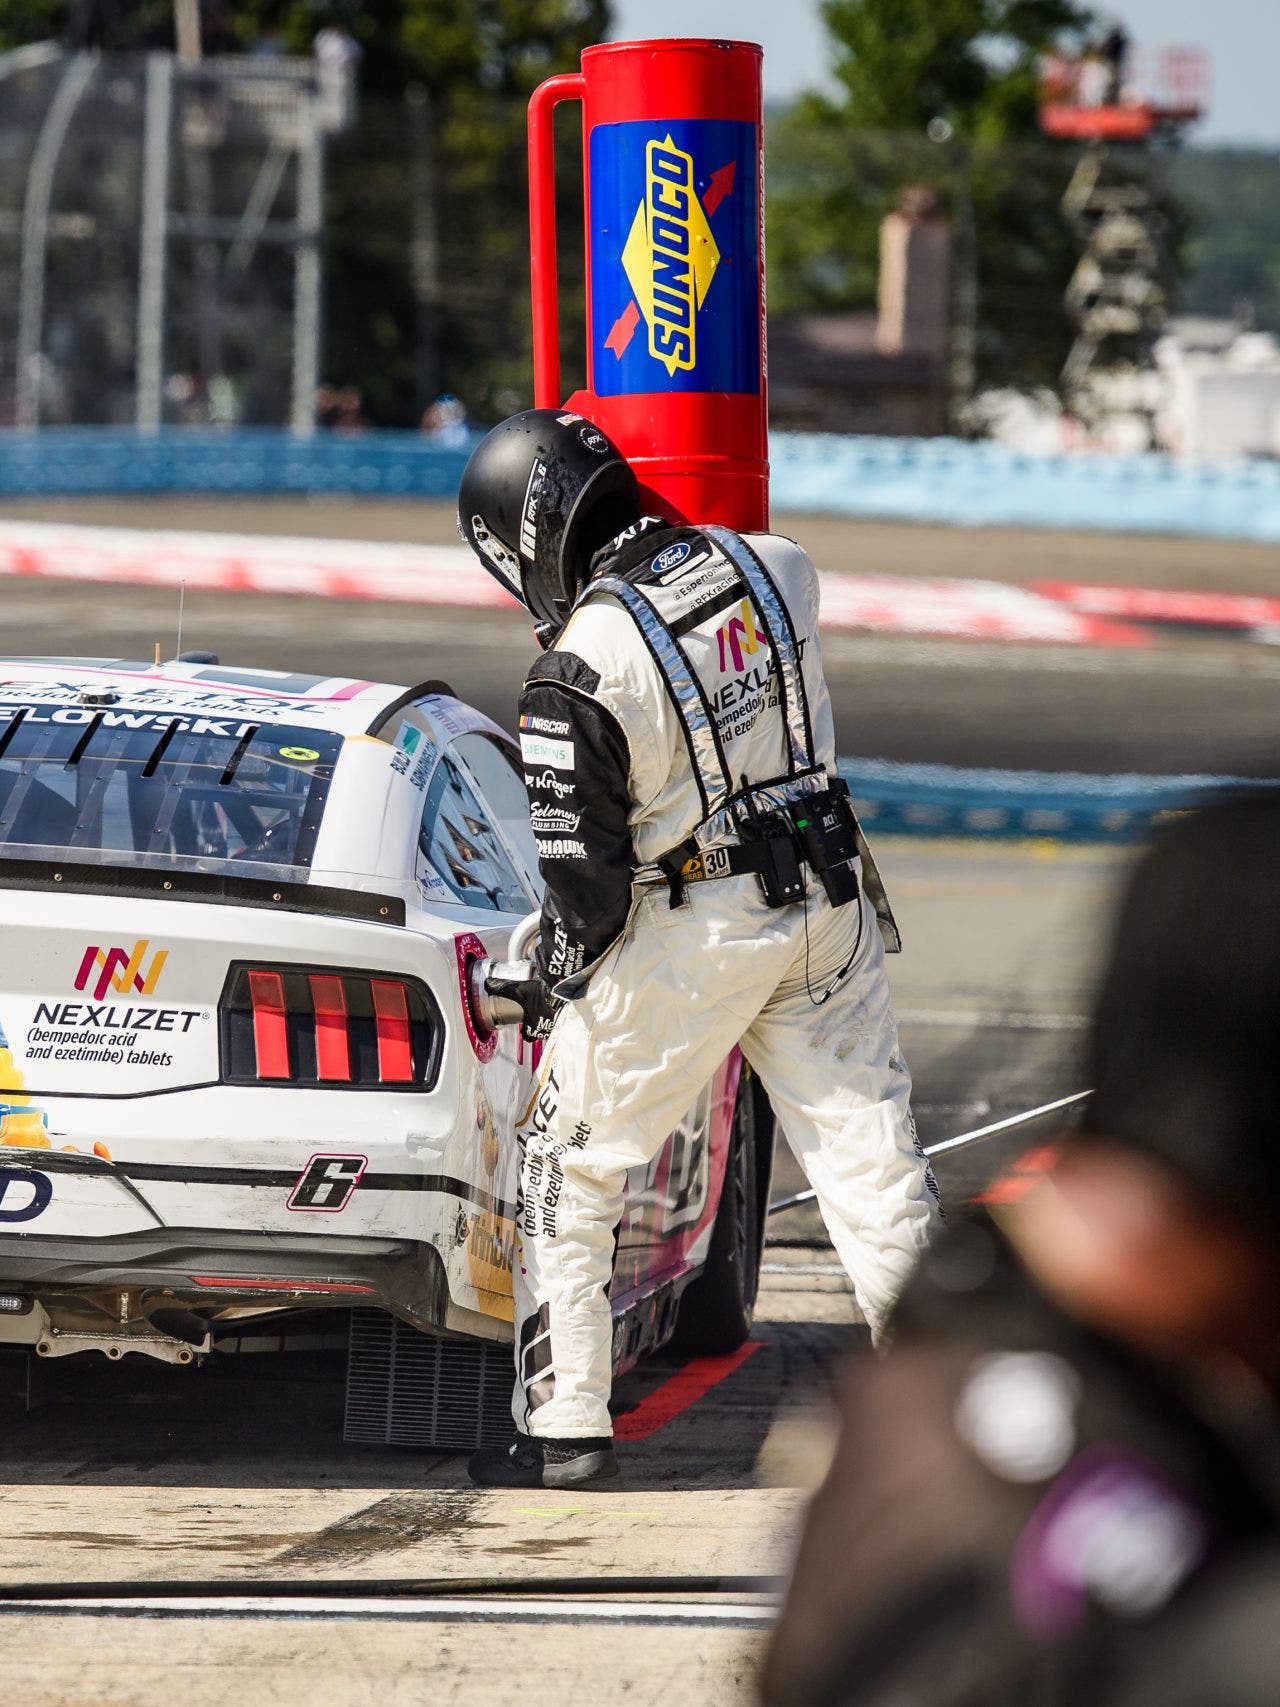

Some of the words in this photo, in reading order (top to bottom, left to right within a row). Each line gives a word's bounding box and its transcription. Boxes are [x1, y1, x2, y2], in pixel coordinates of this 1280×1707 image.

[651, 146, 691, 364] SUNOCO
[658, 548, 685, 568] Ford
[531, 716, 571, 735] NASCAR
[535, 770, 576, 799] Kroger
[532, 820, 570, 829] PLUMBING
[535, 838, 588, 856] OHAWK
[705, 850, 727, 875] 30
[27, 1027, 107, 1047] (bempedoic
[108, 1032, 138, 1047] acid
[25, 1045, 54, 1060] and
[55, 1047, 125, 1066] ezetimibe)
[126, 1050, 173, 1067] tablets
[289, 1155, 366, 1210] 6
[543, 1205, 557, 1239] and
